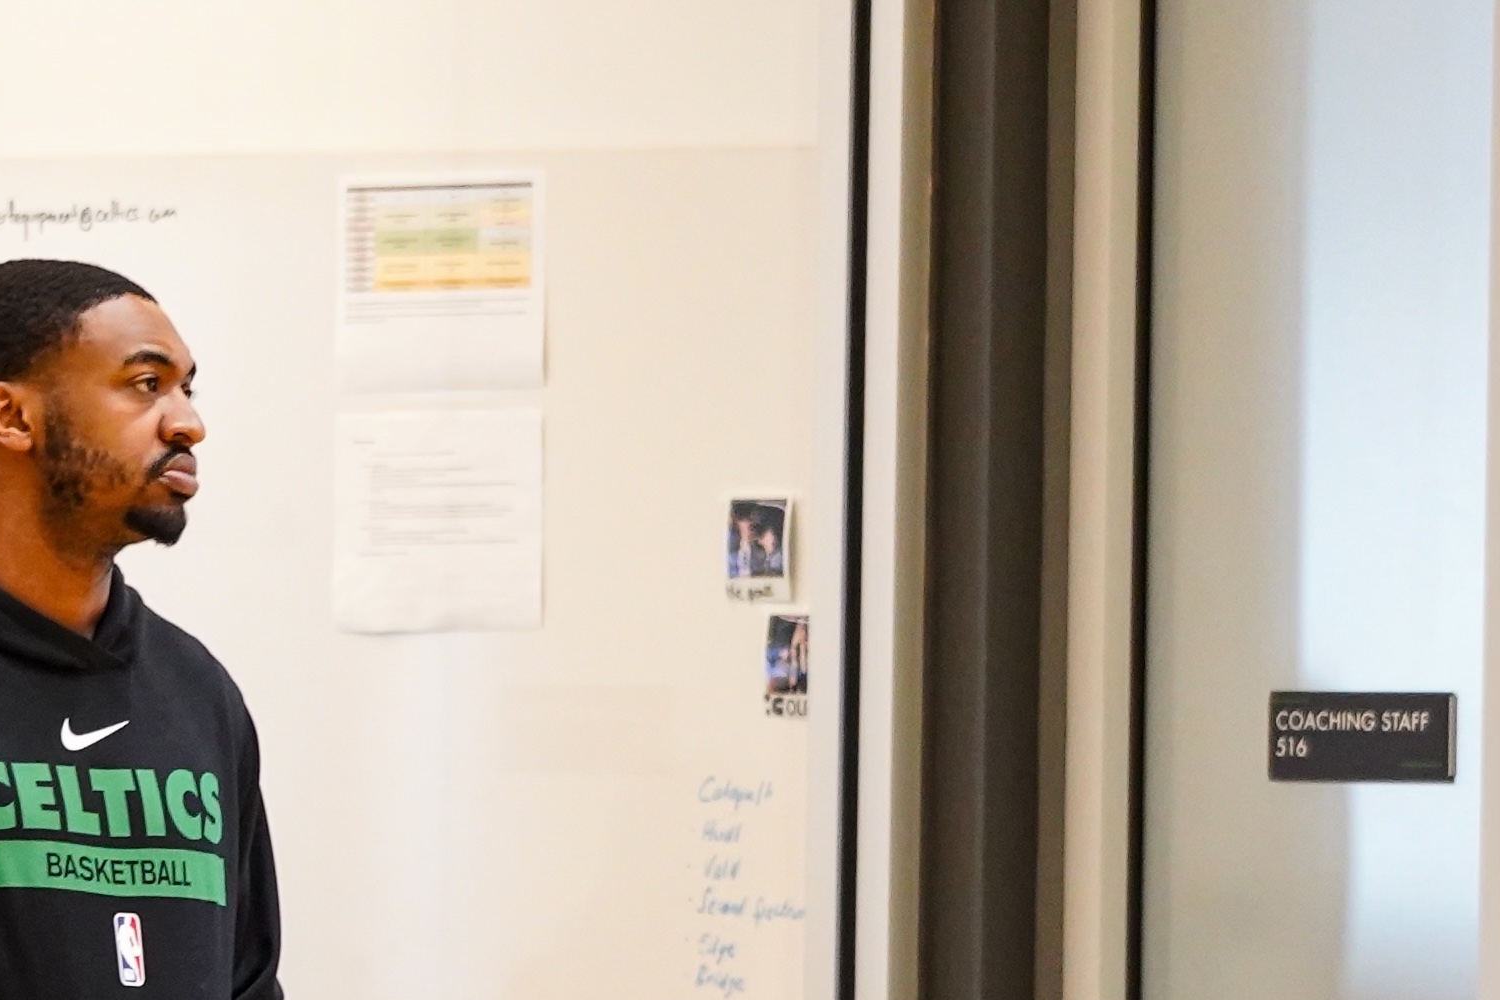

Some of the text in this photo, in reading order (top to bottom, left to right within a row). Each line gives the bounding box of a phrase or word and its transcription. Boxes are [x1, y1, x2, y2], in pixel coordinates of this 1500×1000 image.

[1275, 709, 1430, 732] COACHING STAFF
[1275, 736, 1308, 758] 516
[46, 852, 191, 887] BASKETBALL
